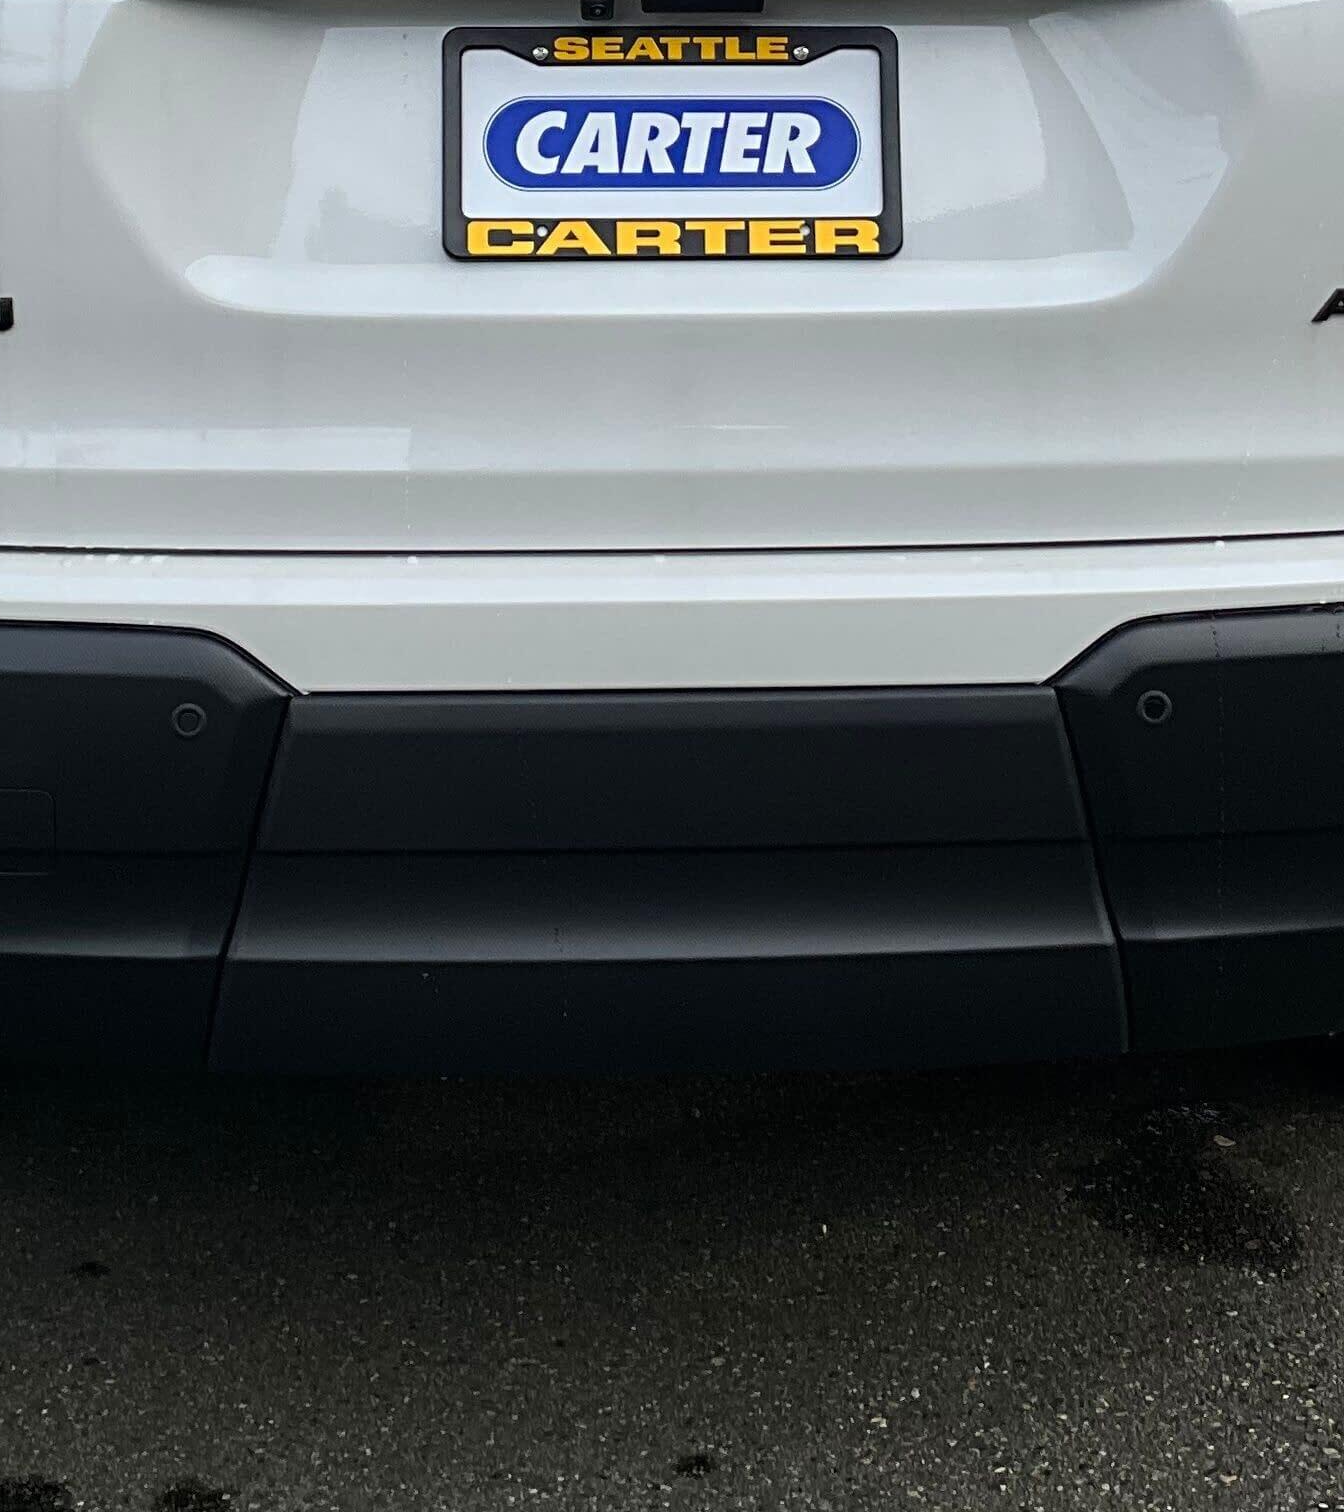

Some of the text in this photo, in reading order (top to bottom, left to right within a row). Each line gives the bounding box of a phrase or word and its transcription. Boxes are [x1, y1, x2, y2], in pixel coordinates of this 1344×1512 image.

[553, 36, 789, 61] SEATTLE
[516, 109, 821, 175] CARTER
[466, 220, 880, 256] CARTER
